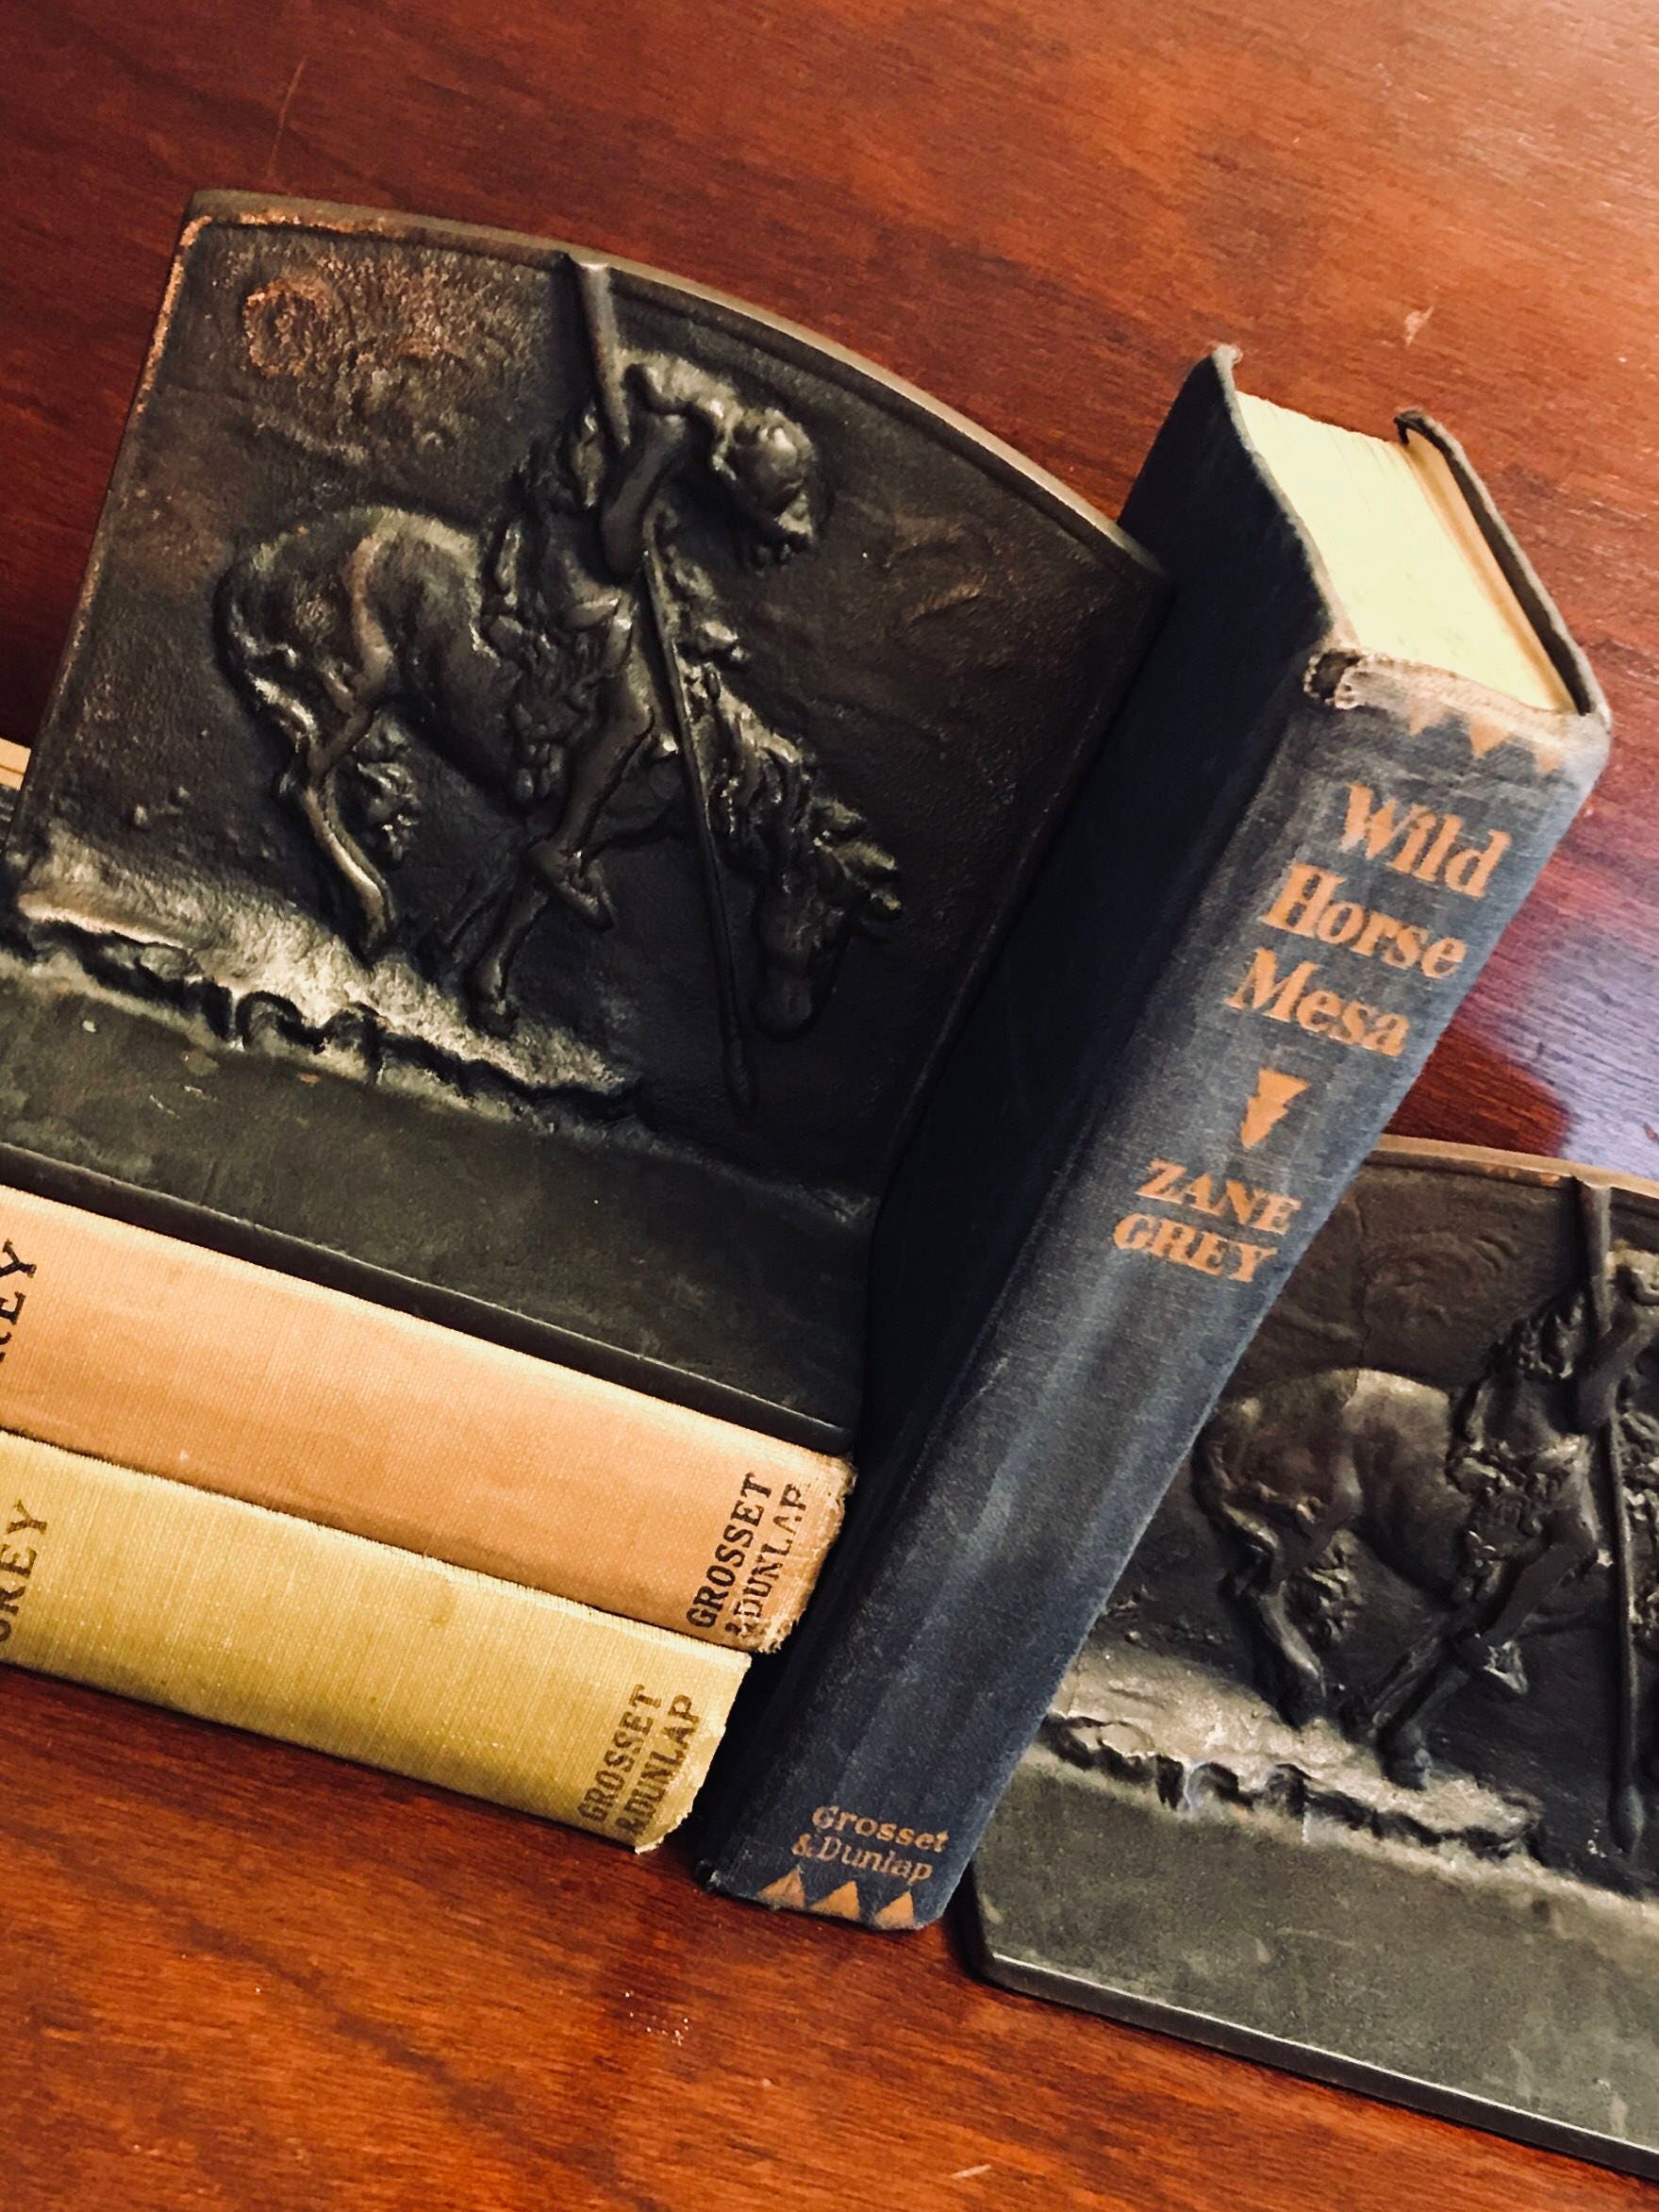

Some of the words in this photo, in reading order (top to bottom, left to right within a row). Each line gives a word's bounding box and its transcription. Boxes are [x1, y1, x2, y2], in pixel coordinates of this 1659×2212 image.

[1341, 782, 1512, 899] Wild
[1258, 861, 1467, 979] Horse
[1227, 946, 1410, 1058] Mesa
[1113, 1212, 1277, 1283] GREY
[1135, 1157, 1303, 1236] ZANE
[686, 1472, 772, 1628] GROSSET
[576, 1684, 662, 1822] GROSSET
[811, 1805, 950, 1854] Grosset
